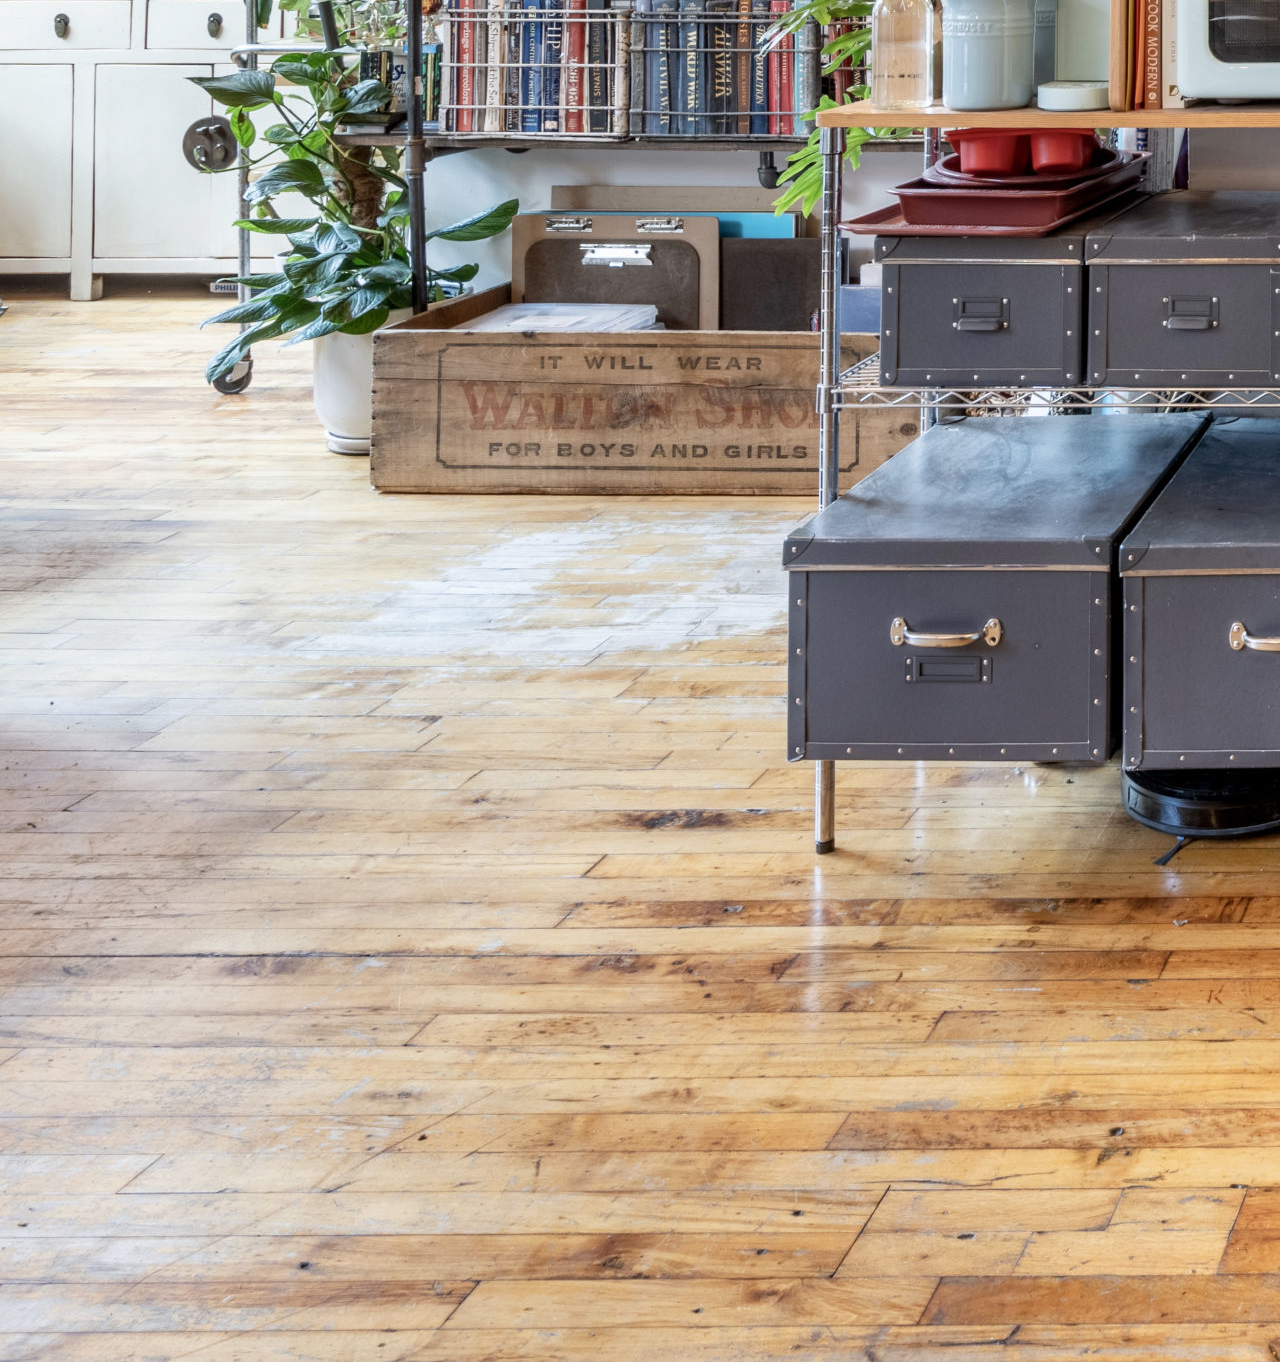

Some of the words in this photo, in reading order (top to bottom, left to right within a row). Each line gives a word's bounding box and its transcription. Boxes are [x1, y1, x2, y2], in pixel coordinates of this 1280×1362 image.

[547, 11, 562, 49] SHIP
[687, 30, 698, 78] WORLD
[1147, 36, 1158, 89] MODERN
[489, 72, 499, 87] the
[510, 48, 519, 106] MASTERPECES
[528, 70, 535, 79] IN
[592, 59, 601, 97] SINATA
[659, 56, 670, 94] CIVIL
[489, 89, 499, 106] Sea
[592, 99, 601, 116] TE
[687, 81, 698, 109] WAR
[659, 100, 669, 125] WAR
[540, 355, 562, 371] IT
[584, 355, 653, 371] WILL
[678, 355, 763, 371] WEAR
[458, 380, 676, 431] WALTON
[488, 442, 542, 457] FOR
[557, 443, 635, 458] BOYS
[650, 443, 709, 458] AND
[724, 444, 809, 459] GIRLS
